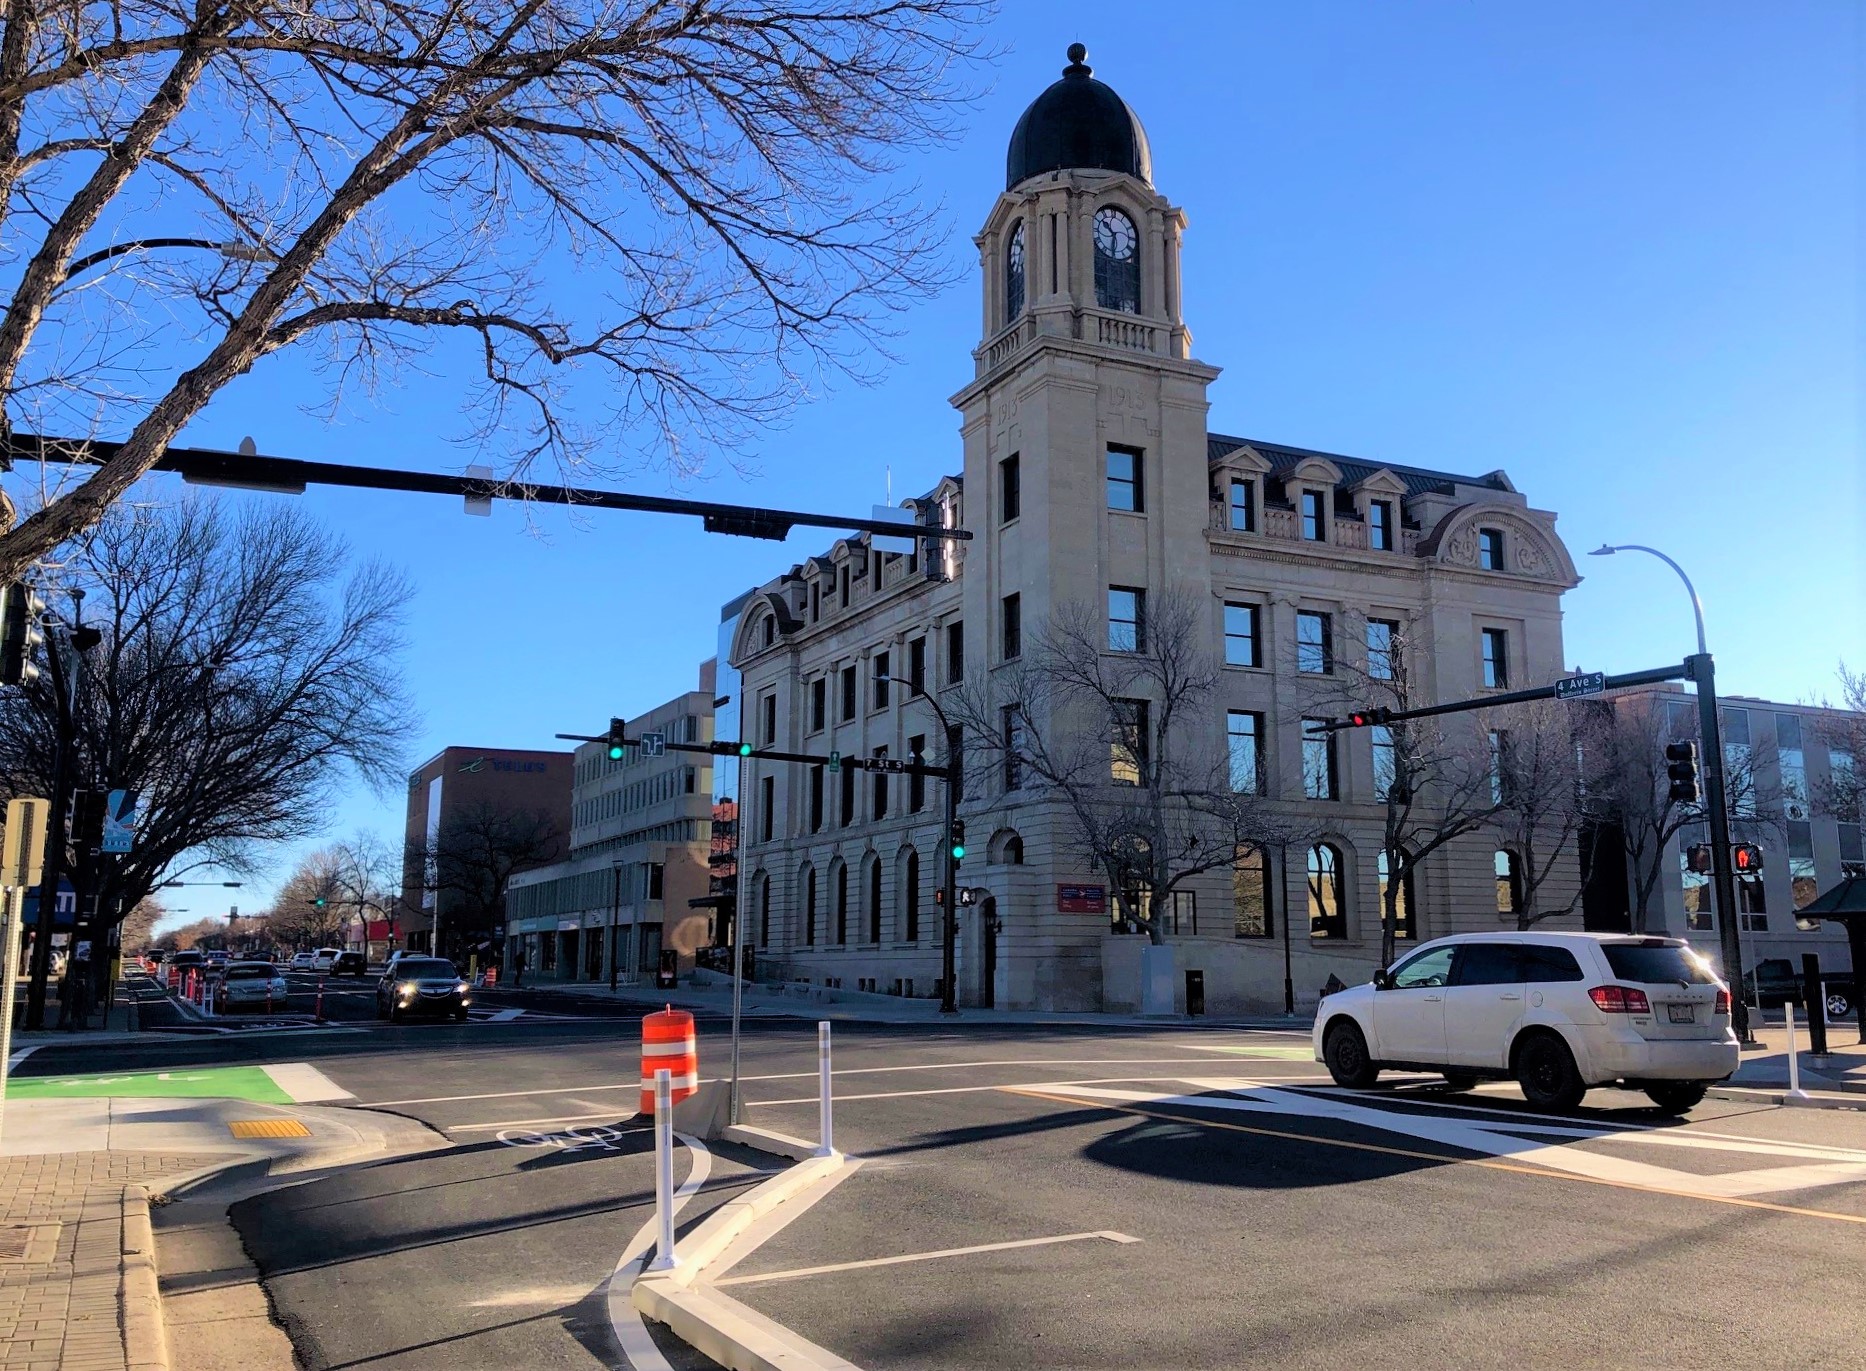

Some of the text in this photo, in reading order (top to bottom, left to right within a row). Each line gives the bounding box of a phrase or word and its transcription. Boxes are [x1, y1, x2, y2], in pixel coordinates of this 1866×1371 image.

[1558, 674, 1602, 691] 4 Ave S
[866, 759, 902, 769] 7 St S
